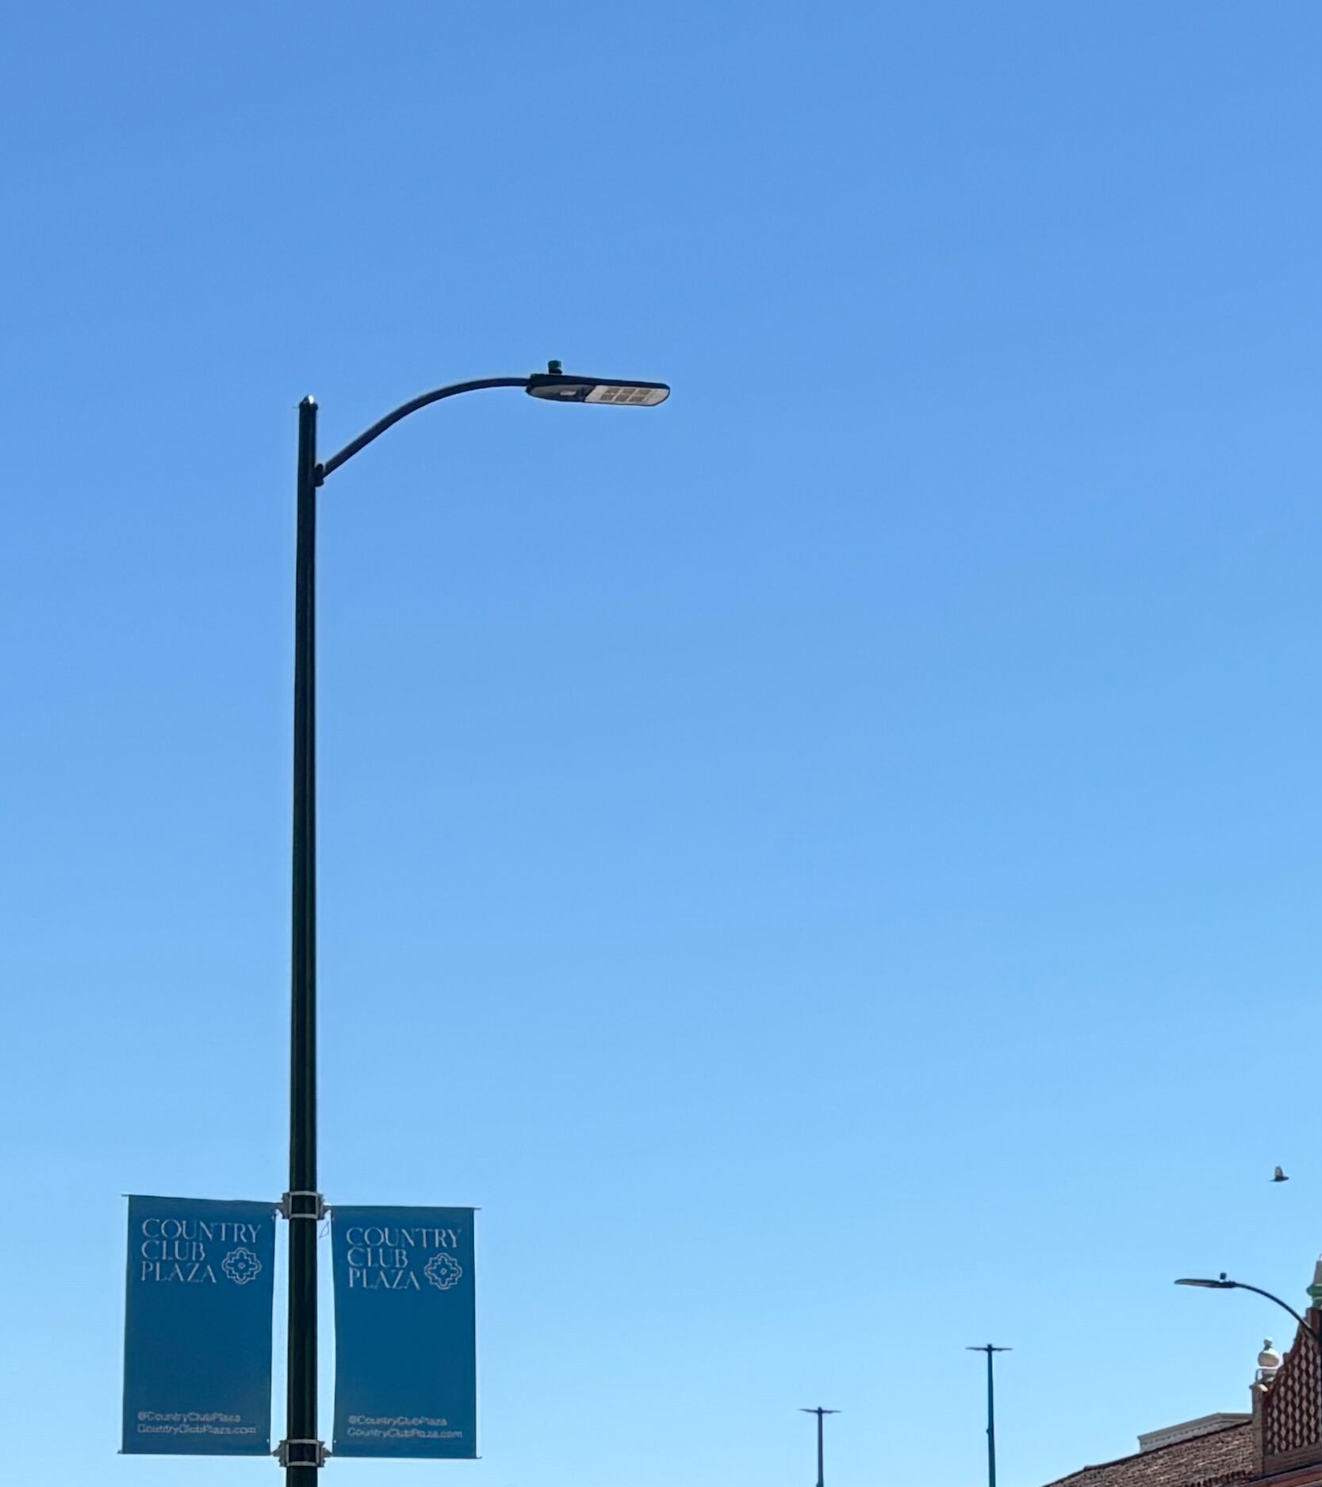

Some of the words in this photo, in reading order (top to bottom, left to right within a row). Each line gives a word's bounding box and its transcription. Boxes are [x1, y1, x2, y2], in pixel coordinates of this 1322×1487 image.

[142, 1218, 261, 1243] COUNTRY
[346, 1226, 462, 1249] COUNTRY
[141, 1240, 206, 1261] CLUB
[347, 1247, 408, 1268] CLUB
[141, 1261, 216, 1283] PLAZA
[348, 1267, 420, 1290] PLAZA
